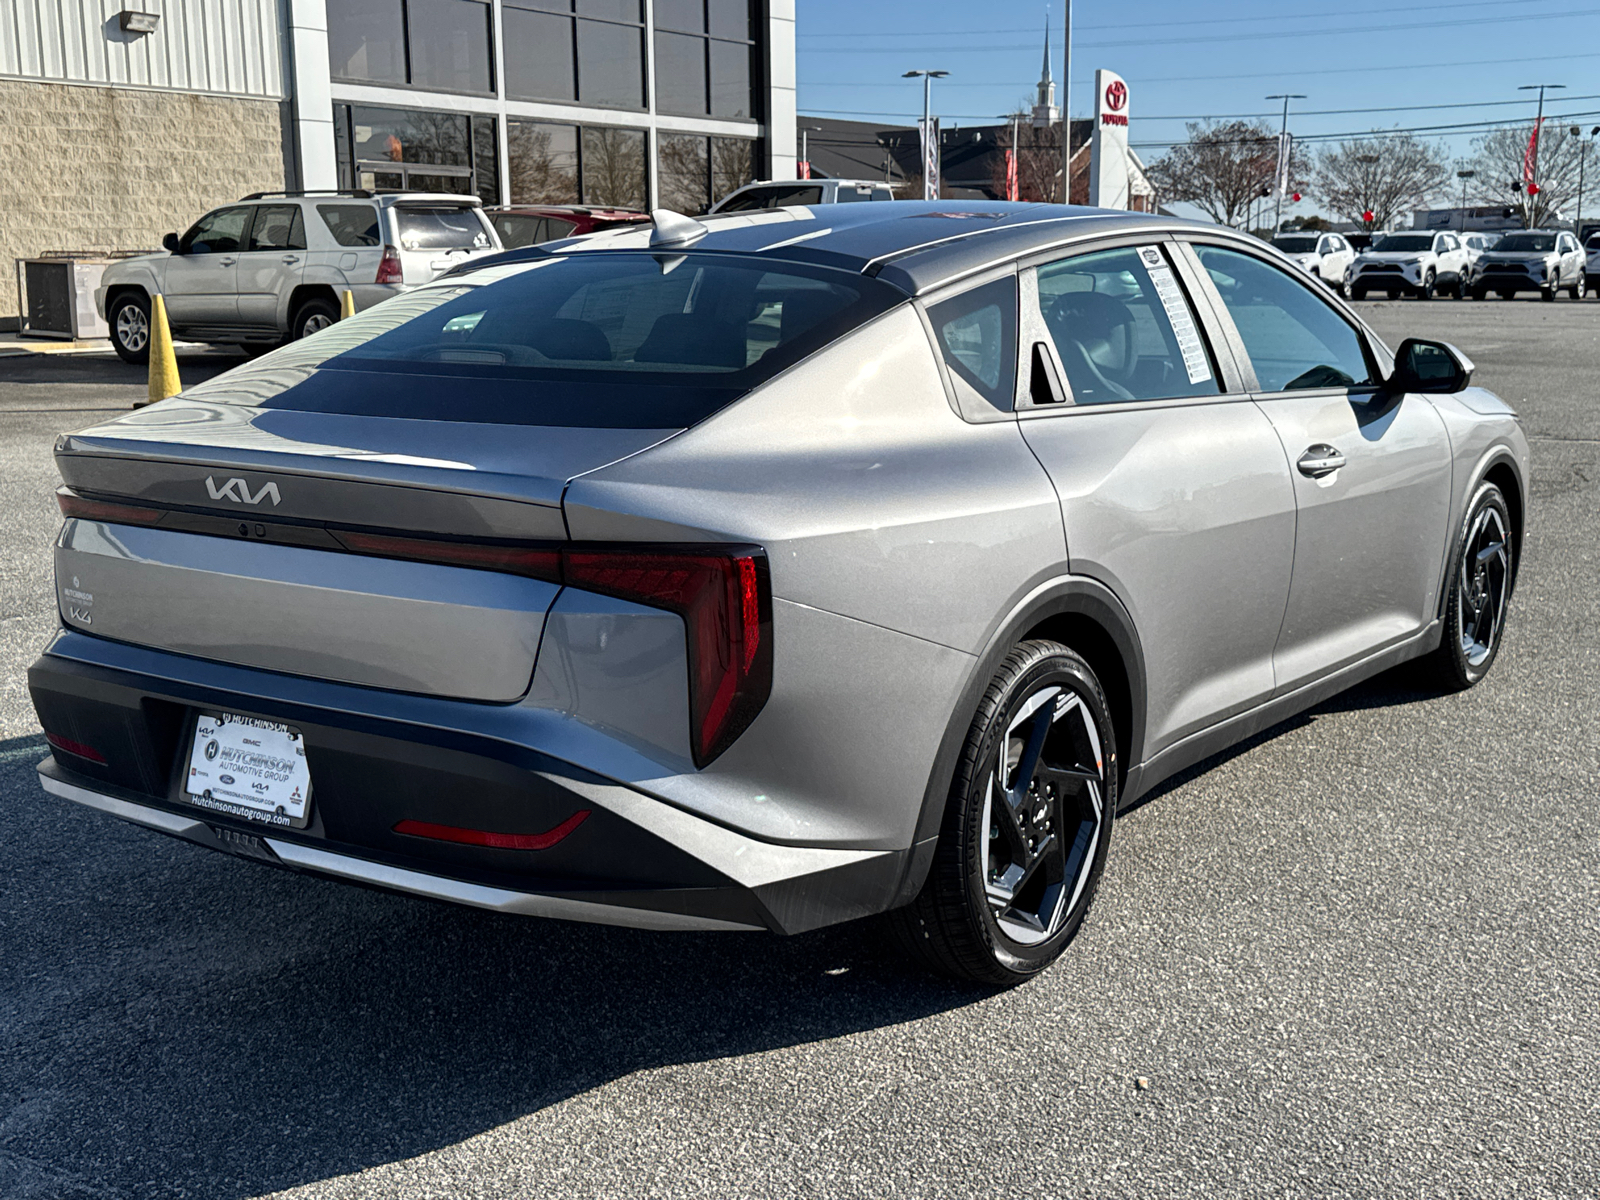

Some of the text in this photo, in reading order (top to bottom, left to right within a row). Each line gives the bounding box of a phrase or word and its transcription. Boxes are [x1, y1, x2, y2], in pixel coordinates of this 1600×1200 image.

[1101, 113, 1128, 126] TOYOTA
[205, 475, 281, 507] KIA
[232, 714, 288, 733] HUTCHINSON
[242, 738, 261, 747] GMC
[220, 746, 295, 774] HUTCHINSON
[219, 761, 289, 782] AUTOMOTIVE GROUP
[191, 795, 291, 826] Hutchinsonautogroup.com
